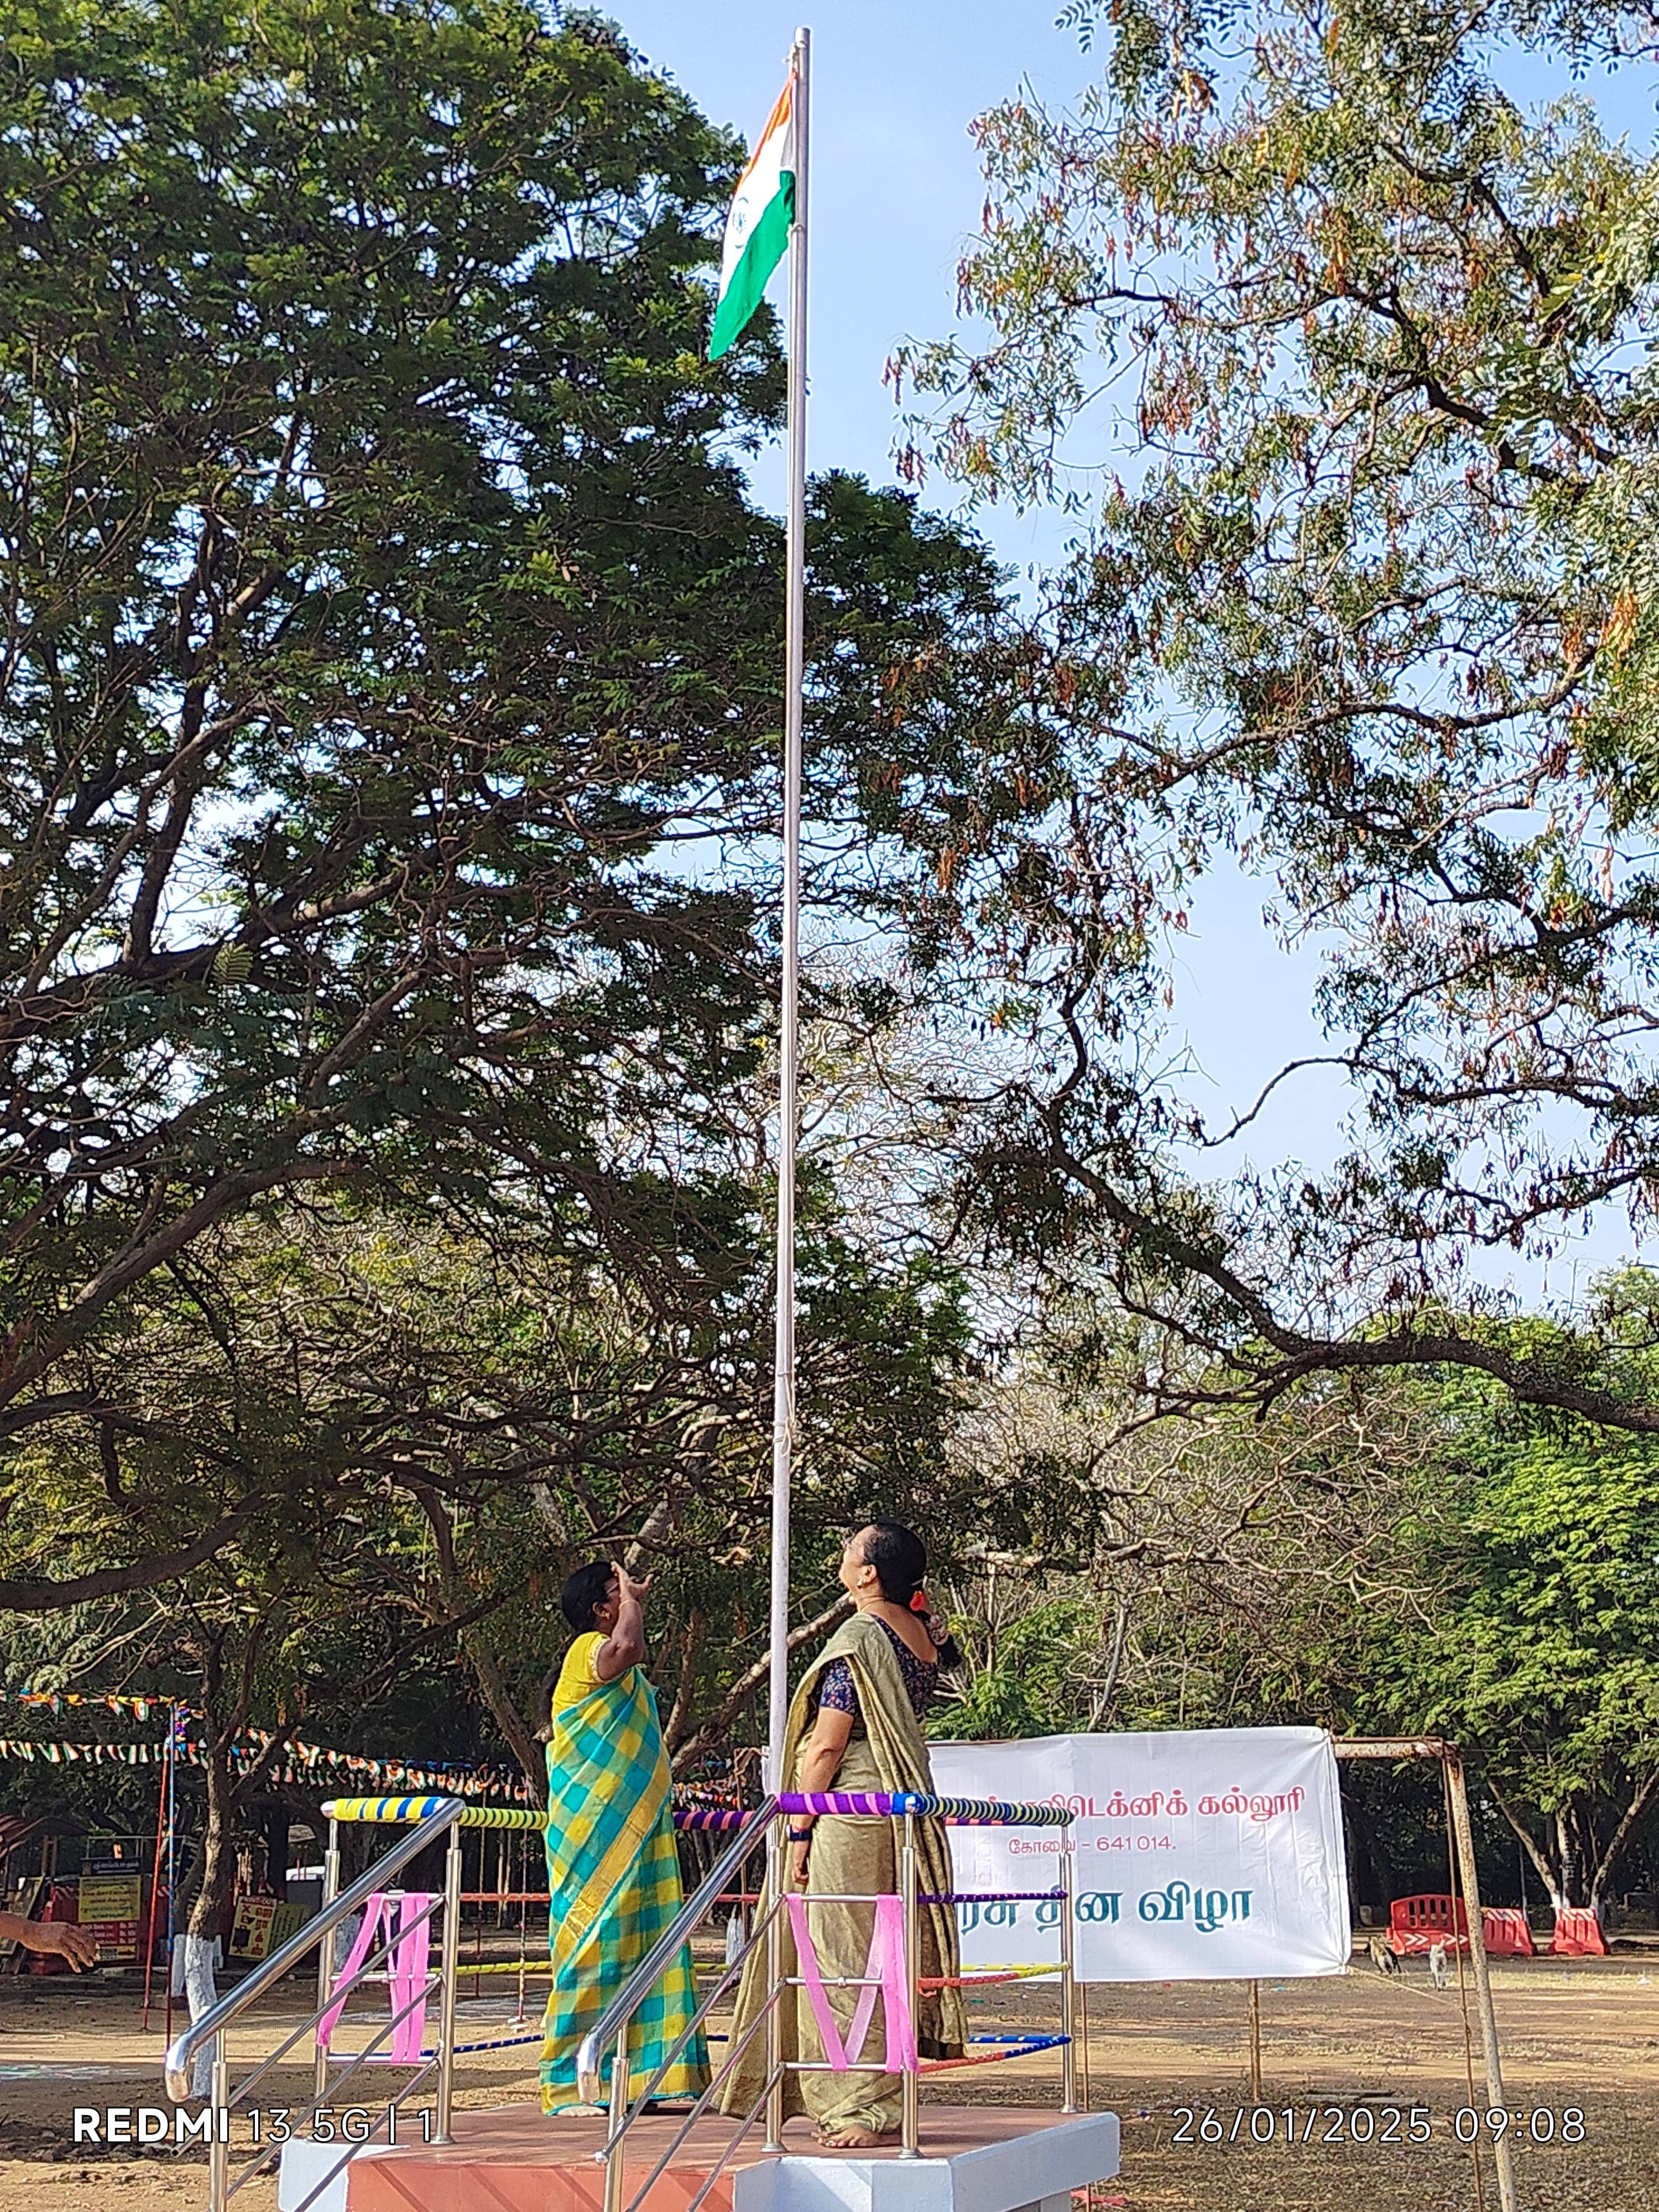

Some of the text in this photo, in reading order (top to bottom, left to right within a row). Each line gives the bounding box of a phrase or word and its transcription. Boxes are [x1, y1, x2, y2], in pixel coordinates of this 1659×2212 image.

[1197, 1786, 1306, 1822] கல்லூரி
[955, 1901, 1020, 1936] ரசு
[1138, 1881, 1254, 1933] விழா
